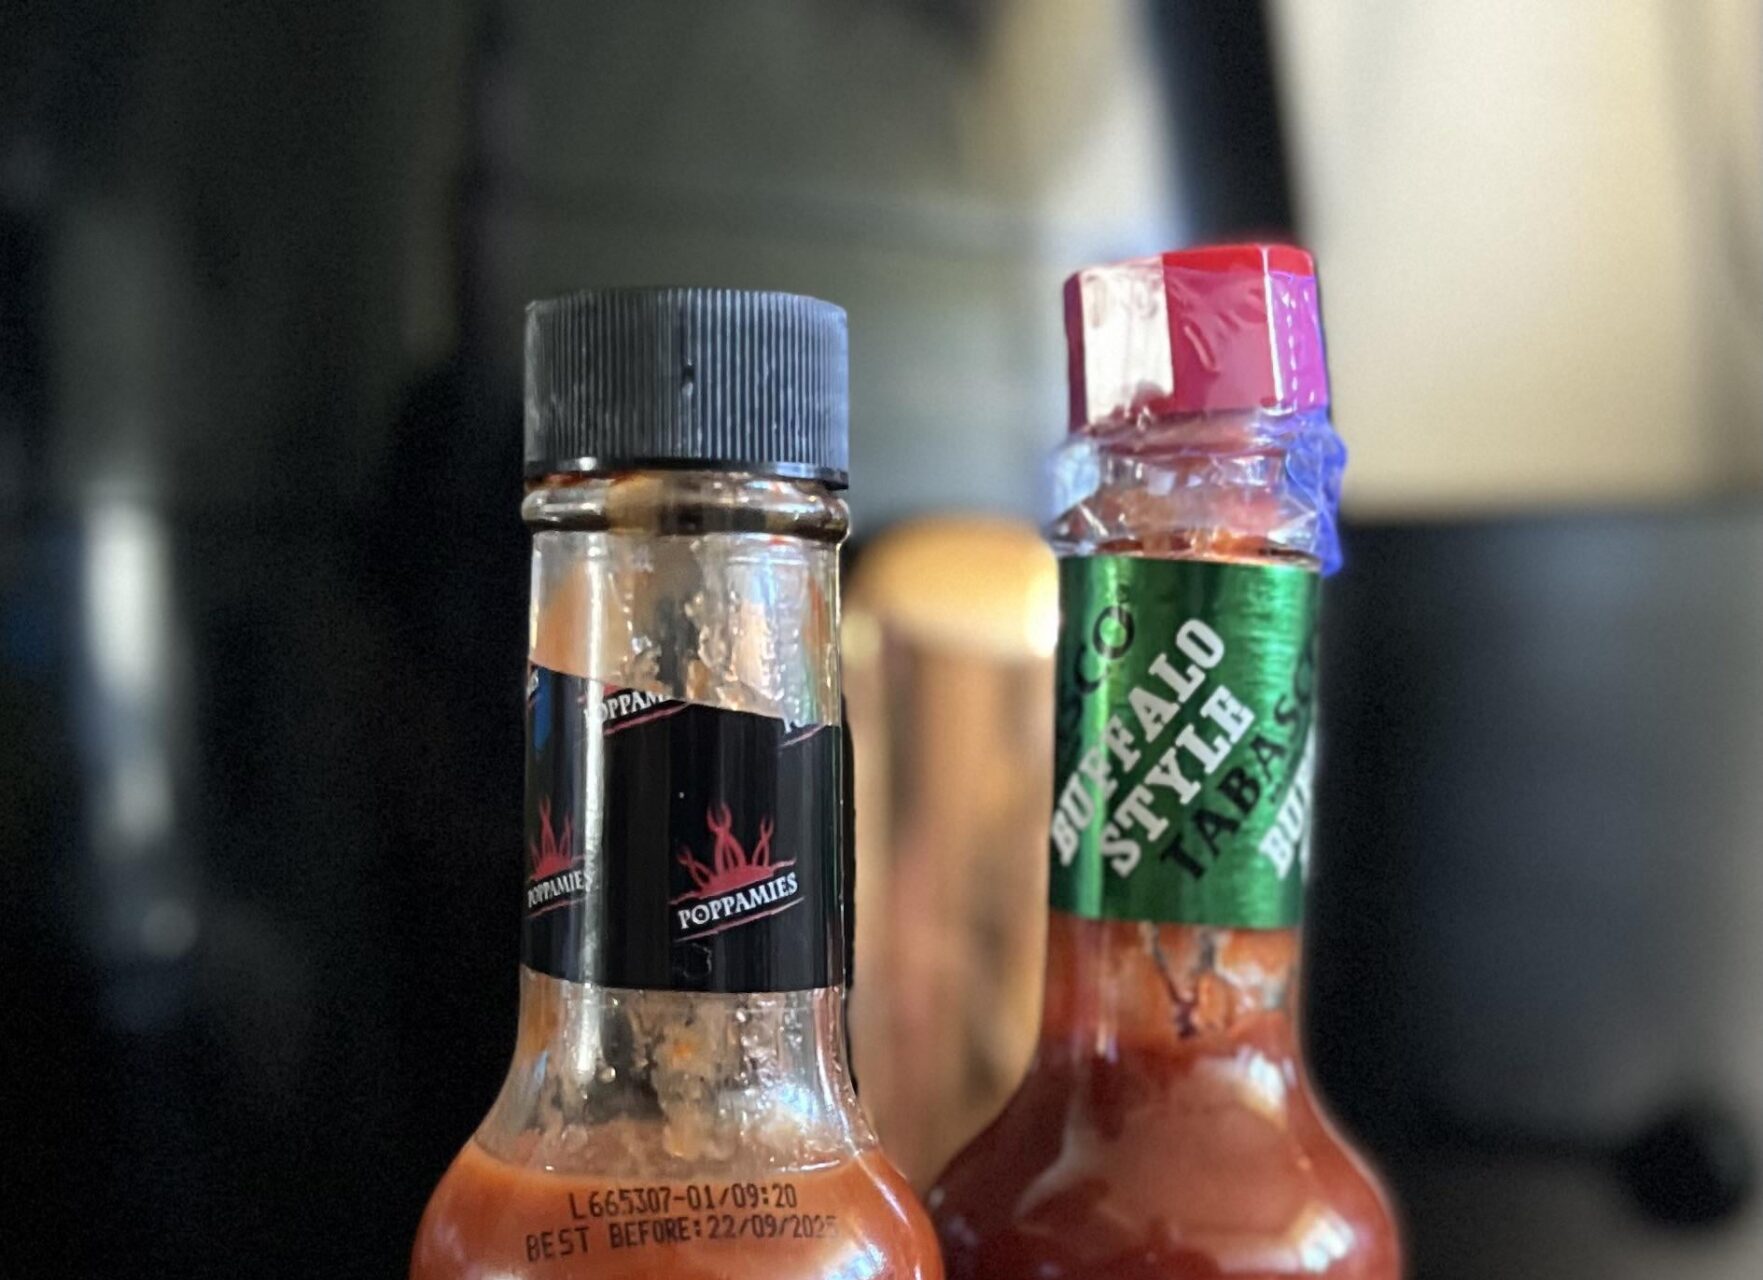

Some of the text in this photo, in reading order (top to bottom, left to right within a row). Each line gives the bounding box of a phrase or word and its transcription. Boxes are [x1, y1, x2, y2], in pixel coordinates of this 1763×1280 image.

[1050, 618, 1224, 866] BUFFALO
[1099, 685, 1255, 878] STYLE
[678, 872, 798, 929] POPPAMIES
[568, 1183, 797, 1220] L665307-01/09:20
[526, 1227, 589, 1263] BEST
